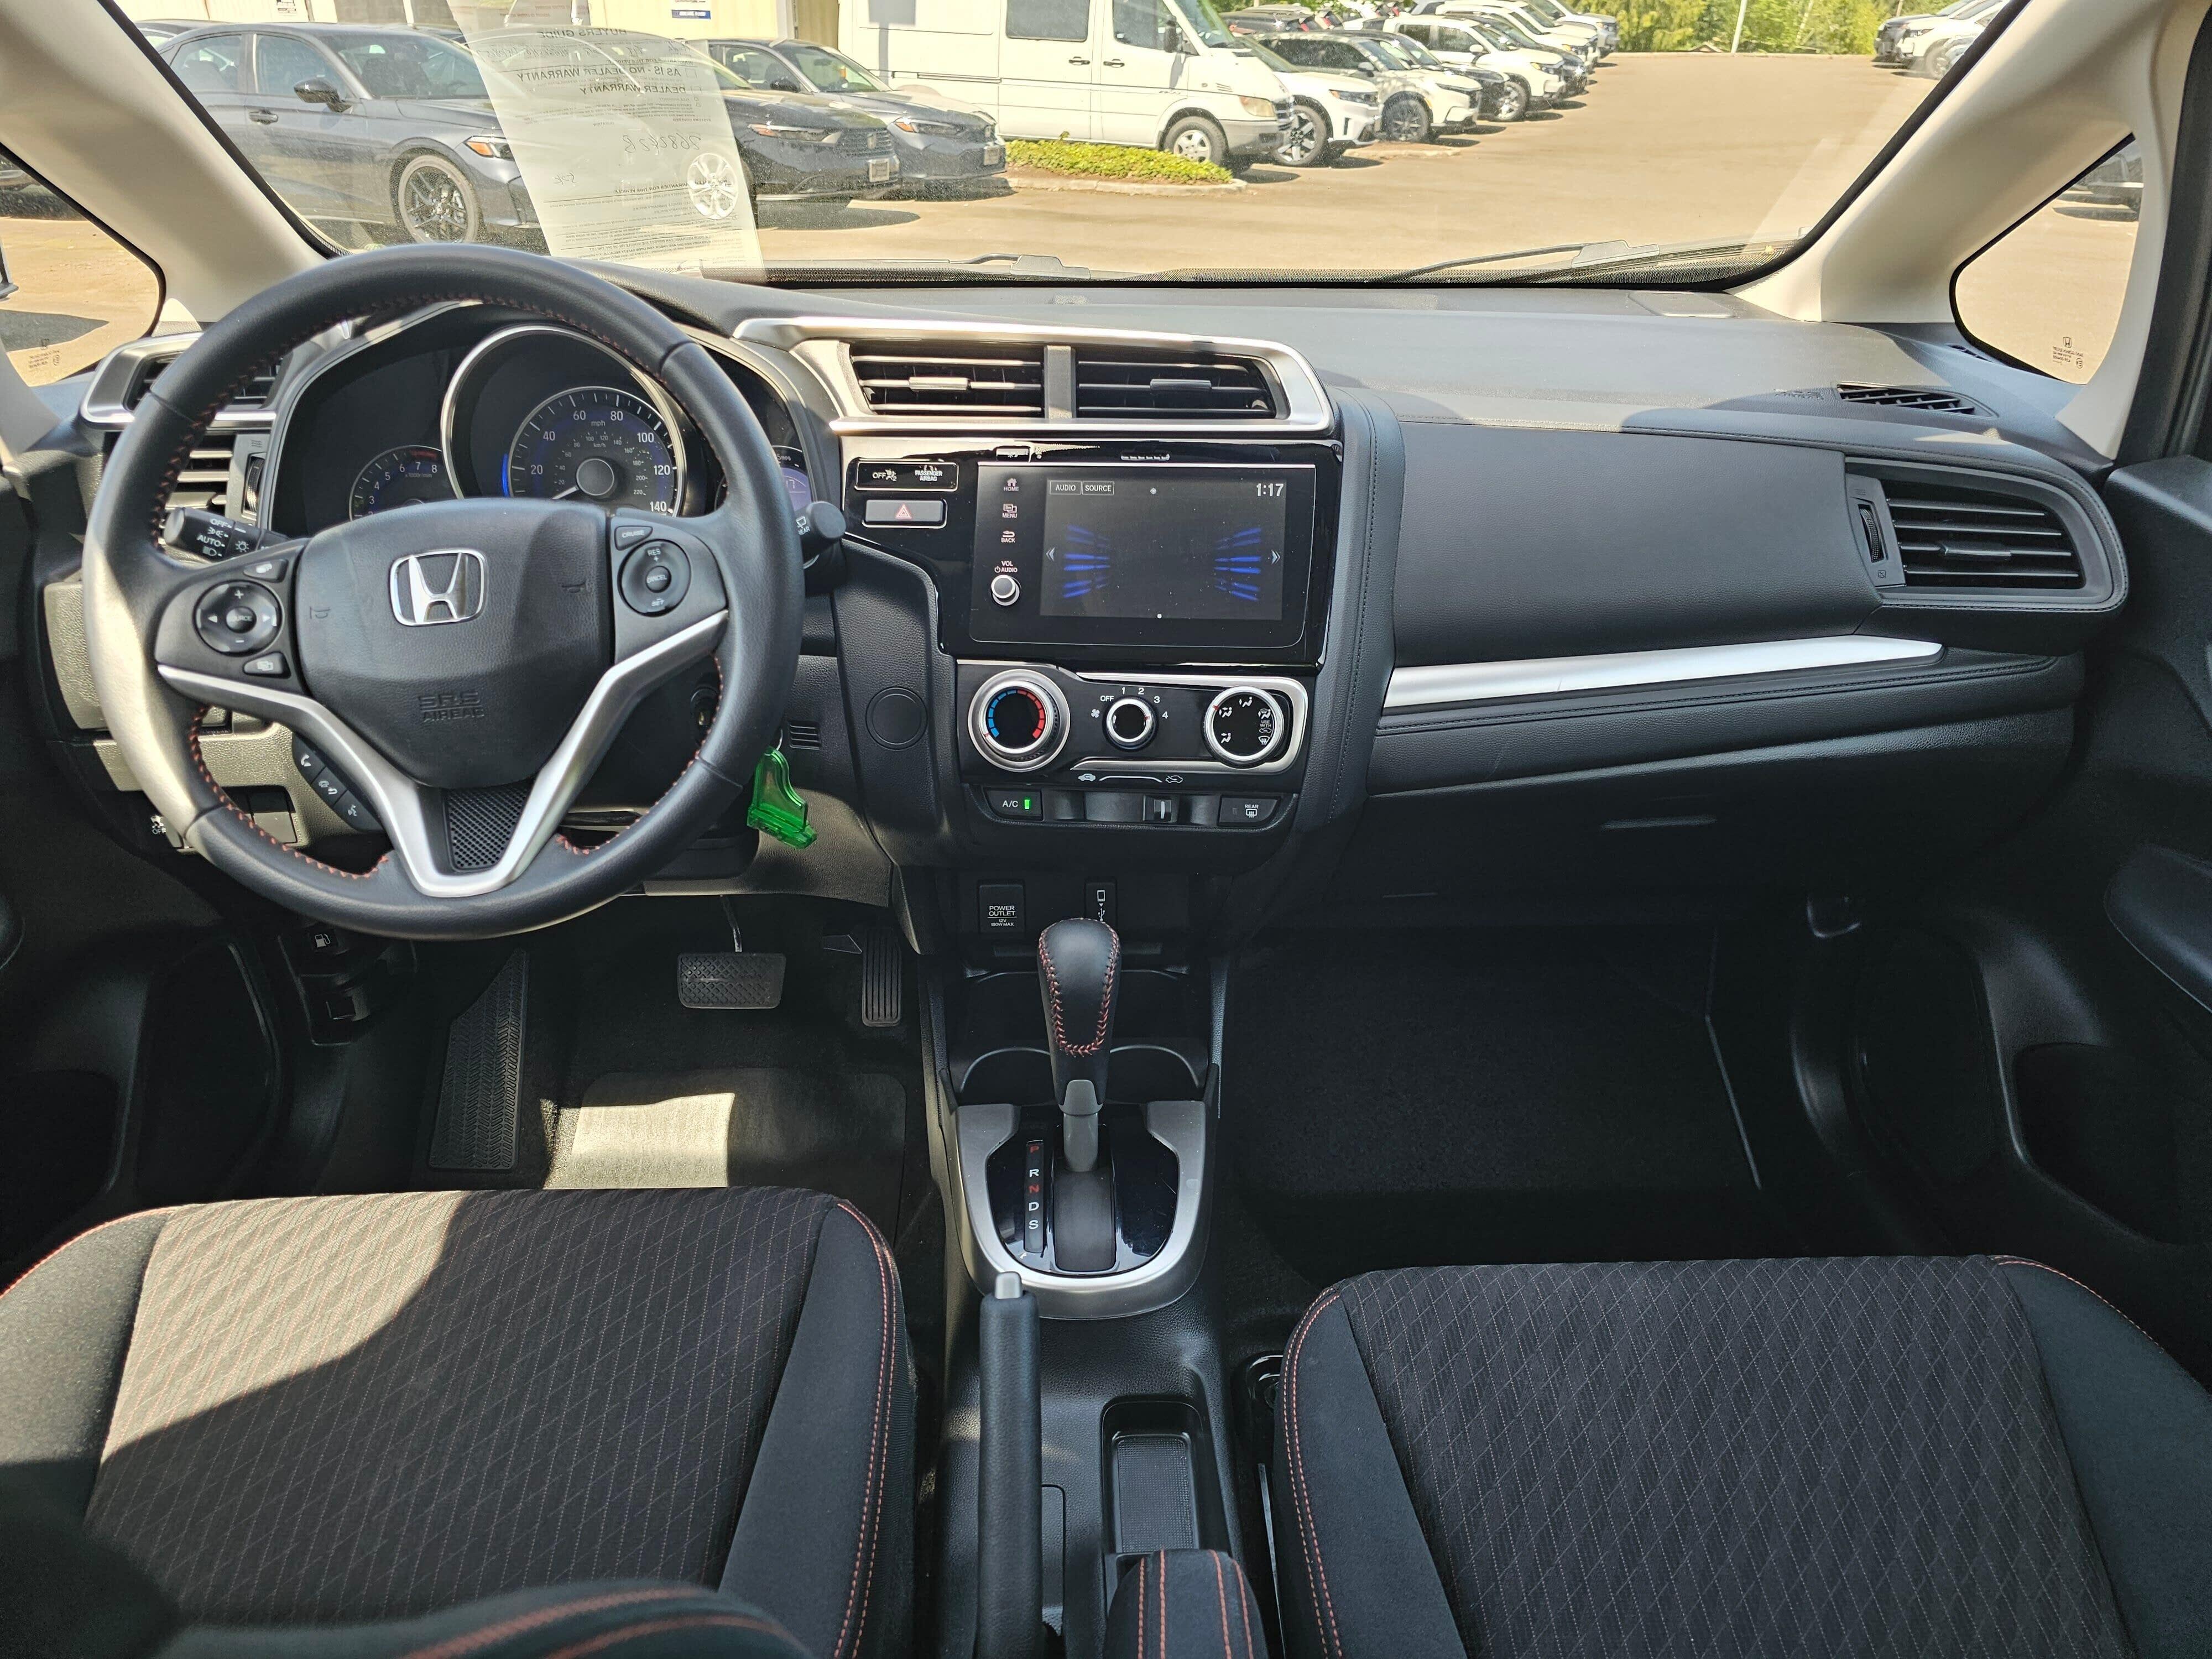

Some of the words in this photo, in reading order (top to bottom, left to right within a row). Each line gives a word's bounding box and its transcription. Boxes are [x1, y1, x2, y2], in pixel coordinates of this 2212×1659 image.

[573, 410, 586, 420] 60
[610, 411, 623, 421] 80
[543, 431, 555, 441] 40
[637, 432, 654, 443] 100
[399, 464, 405, 472] 6
[415, 462, 421, 471] 7
[431, 465, 437, 473] 8
[530, 465, 543, 474] 20
[654, 465, 670, 475] 120
[385, 472, 390, 481] 5
[1256, 483, 1284, 497] 1:17
[369, 496, 374, 504] 3
[650, 502, 667, 512] 140
[210, 518, 228, 528] OFF
[622, 530, 645, 538] CRUISE
[196, 534, 221, 547] AUTO
[1121, 687, 1125, 695] 1
[1154, 696, 1160, 704] 3
[1029, 1168, 1040, 1177] R
[1029, 1185, 1040, 1194] N
[1029, 1202, 1040, 1211] D
[1029, 1219, 1039, 1229] S
